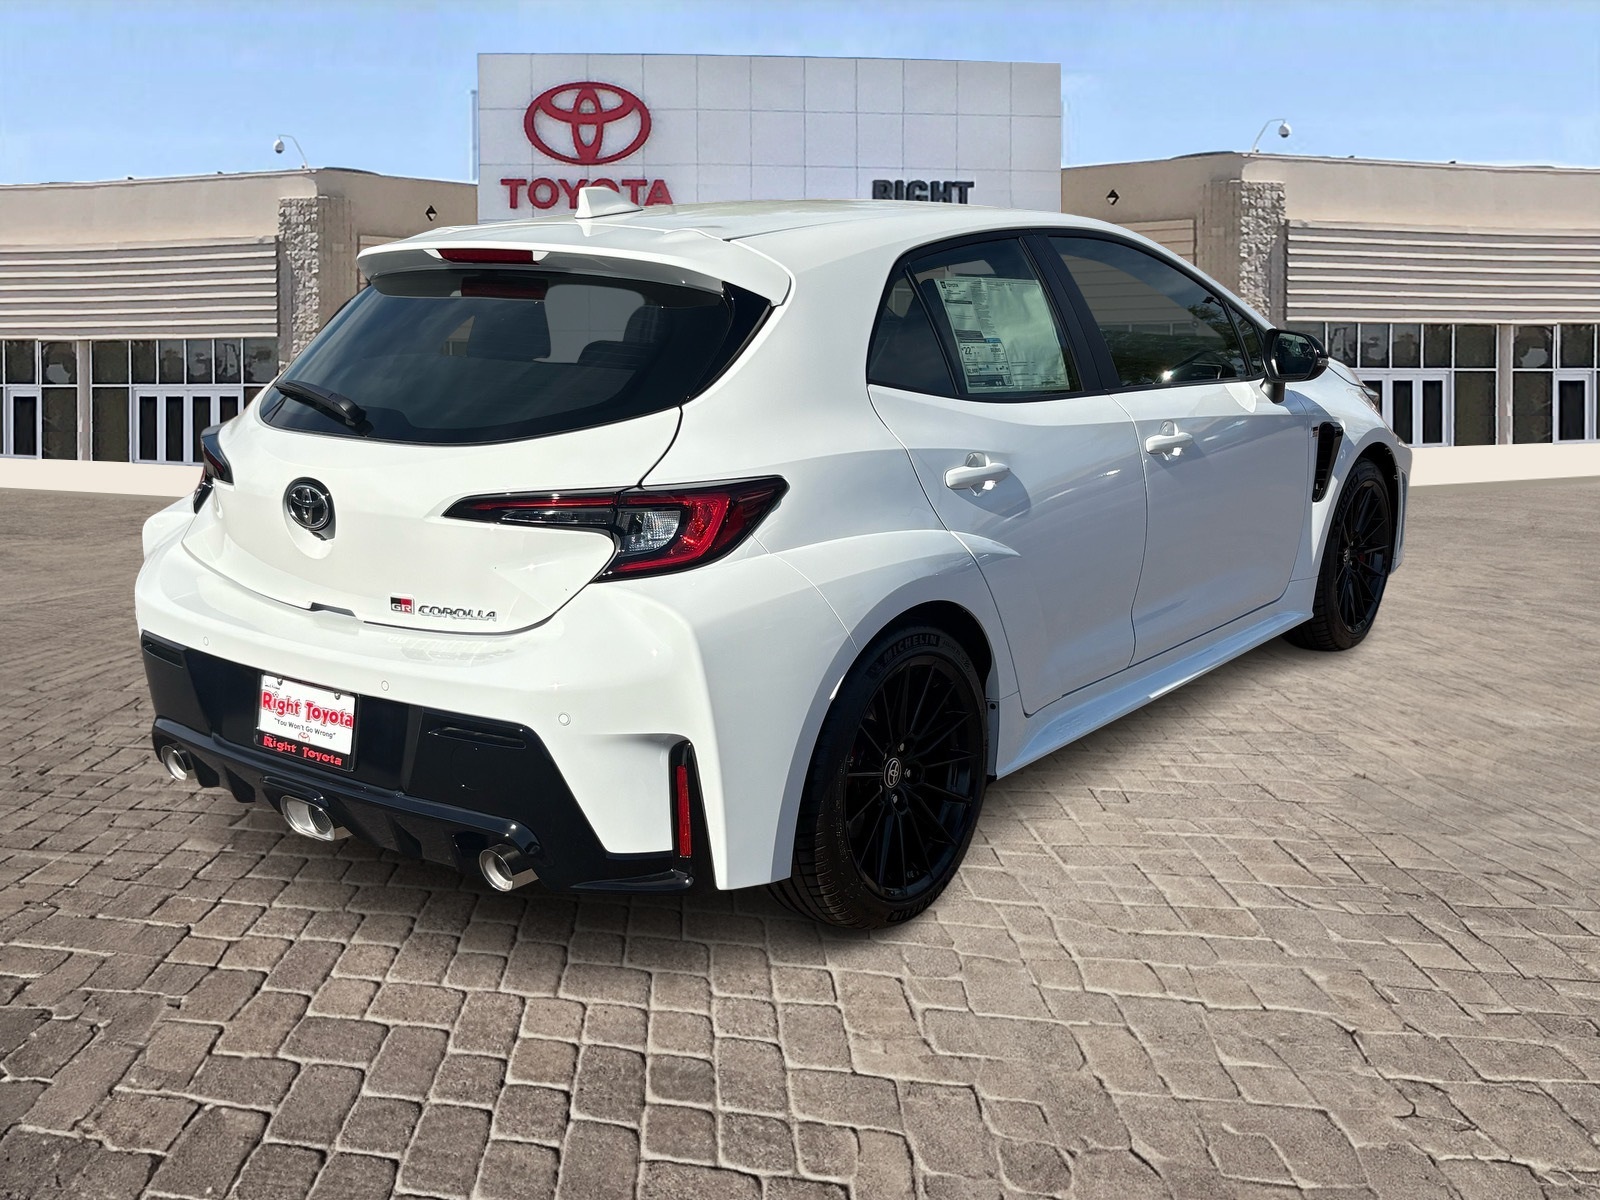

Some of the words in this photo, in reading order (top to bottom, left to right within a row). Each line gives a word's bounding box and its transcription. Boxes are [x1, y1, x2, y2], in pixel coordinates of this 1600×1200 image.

[500, 178, 673, 209] TOYTA
[872, 179, 975, 204] RIGHT
[418, 605, 497, 621] COROLLA
[882, 635, 939, 662] MICHELIN
[262, 691, 301, 717] Right
[305, 701, 354, 728] Toyota
[263, 735, 297, 752] Right
[303, 747, 342, 765] Toyota
